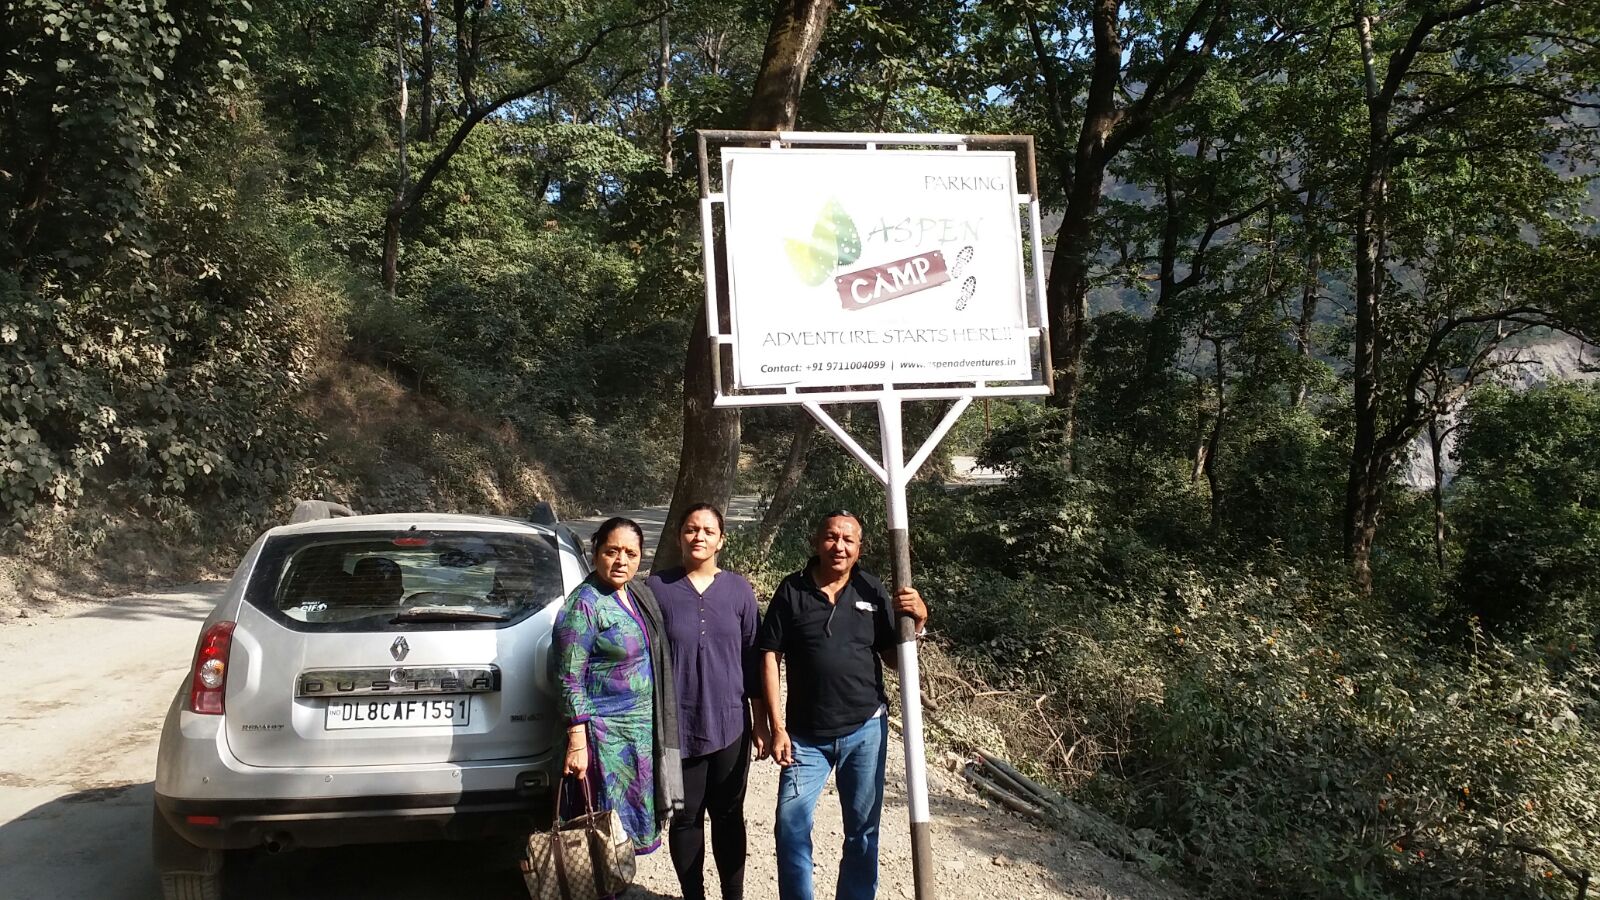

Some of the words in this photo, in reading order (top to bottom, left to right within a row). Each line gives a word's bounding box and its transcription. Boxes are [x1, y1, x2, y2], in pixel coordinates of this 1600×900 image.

[924, 175, 1004, 191] PARKING
[867, 216, 983, 248] ASPEN
[850, 257, 930, 304] CAMP
[763, 329, 879, 347] ADVENTURE
[882, 328, 949, 344] STARTS
[953, 326, 1012, 342] HERE!!
[760, 363, 803, 373] Contact:
[806, 361, 823, 371] +91
[826, 360, 886, 371] 9711004099
[900, 357, 1016, 369] www.spenadventures.in
[305, 678, 490, 693] DUSTER
[342, 702, 466, 721] DL8CAF1551
